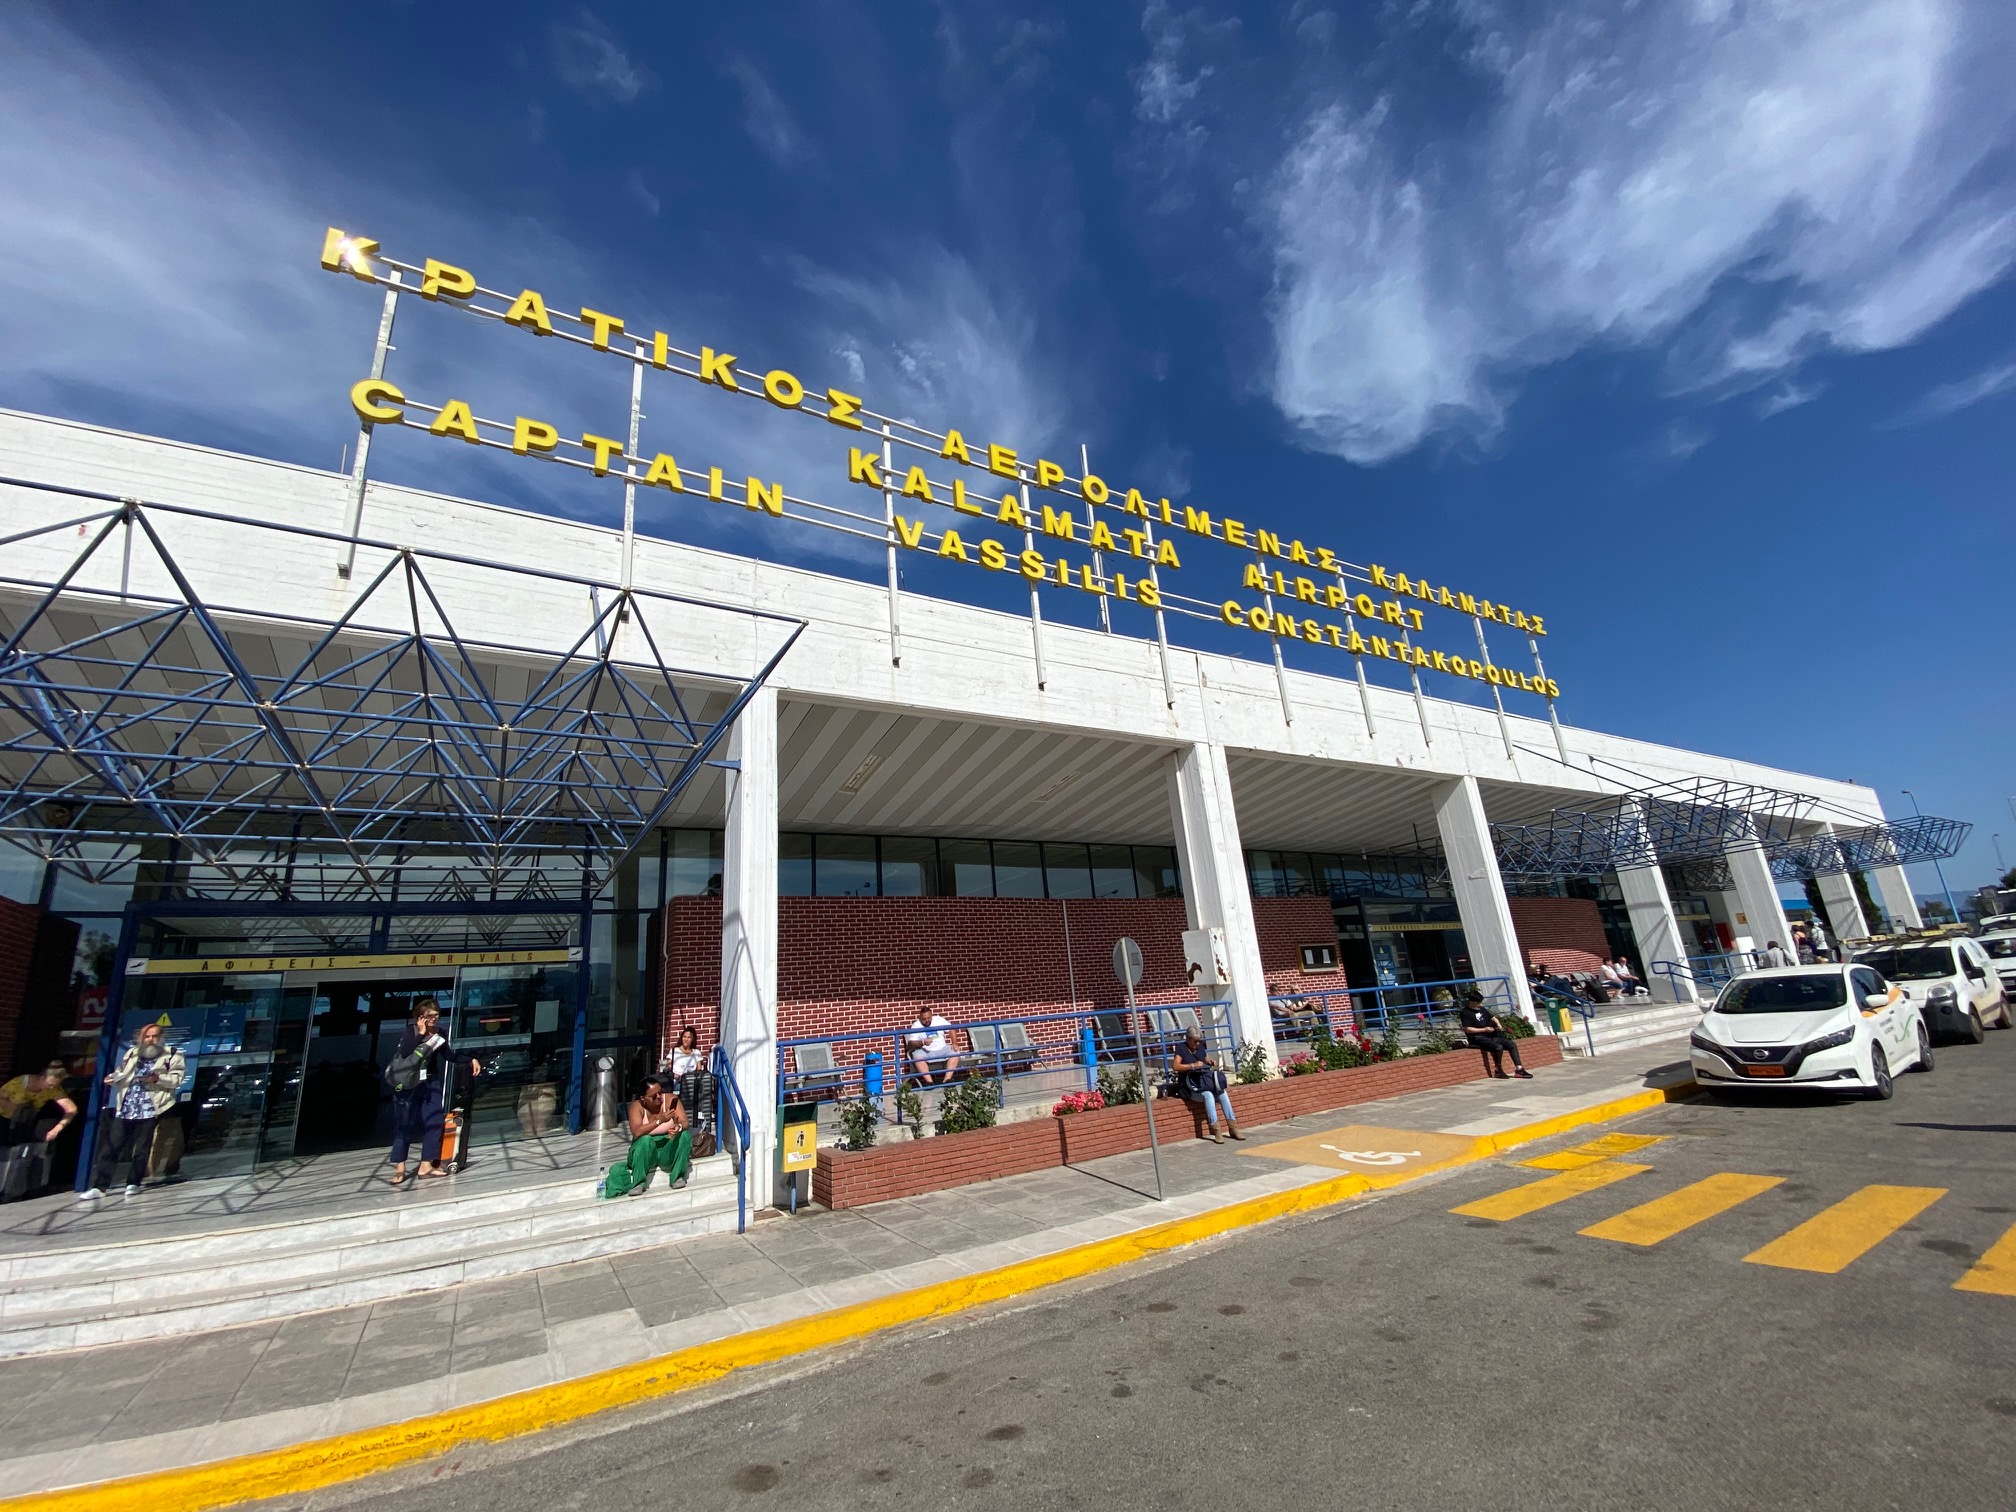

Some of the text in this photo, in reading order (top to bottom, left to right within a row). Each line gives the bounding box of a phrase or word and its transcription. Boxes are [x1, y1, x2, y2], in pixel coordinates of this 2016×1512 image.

[321, 227, 1547, 636] ΚΡΑΤΙΚΟΣ ΑΕΡΟΛΙΜΕΝΑΣ ΚΑΛΑΜΑΤΑΣ
[350, 378, 1560, 698] CAPTAIN VASSILIS CONSTANTAKOPOULOS
[848, 447, 1424, 632] KALAMATA AIRPORT
[411, 952, 534, 966] ARRIVALS
